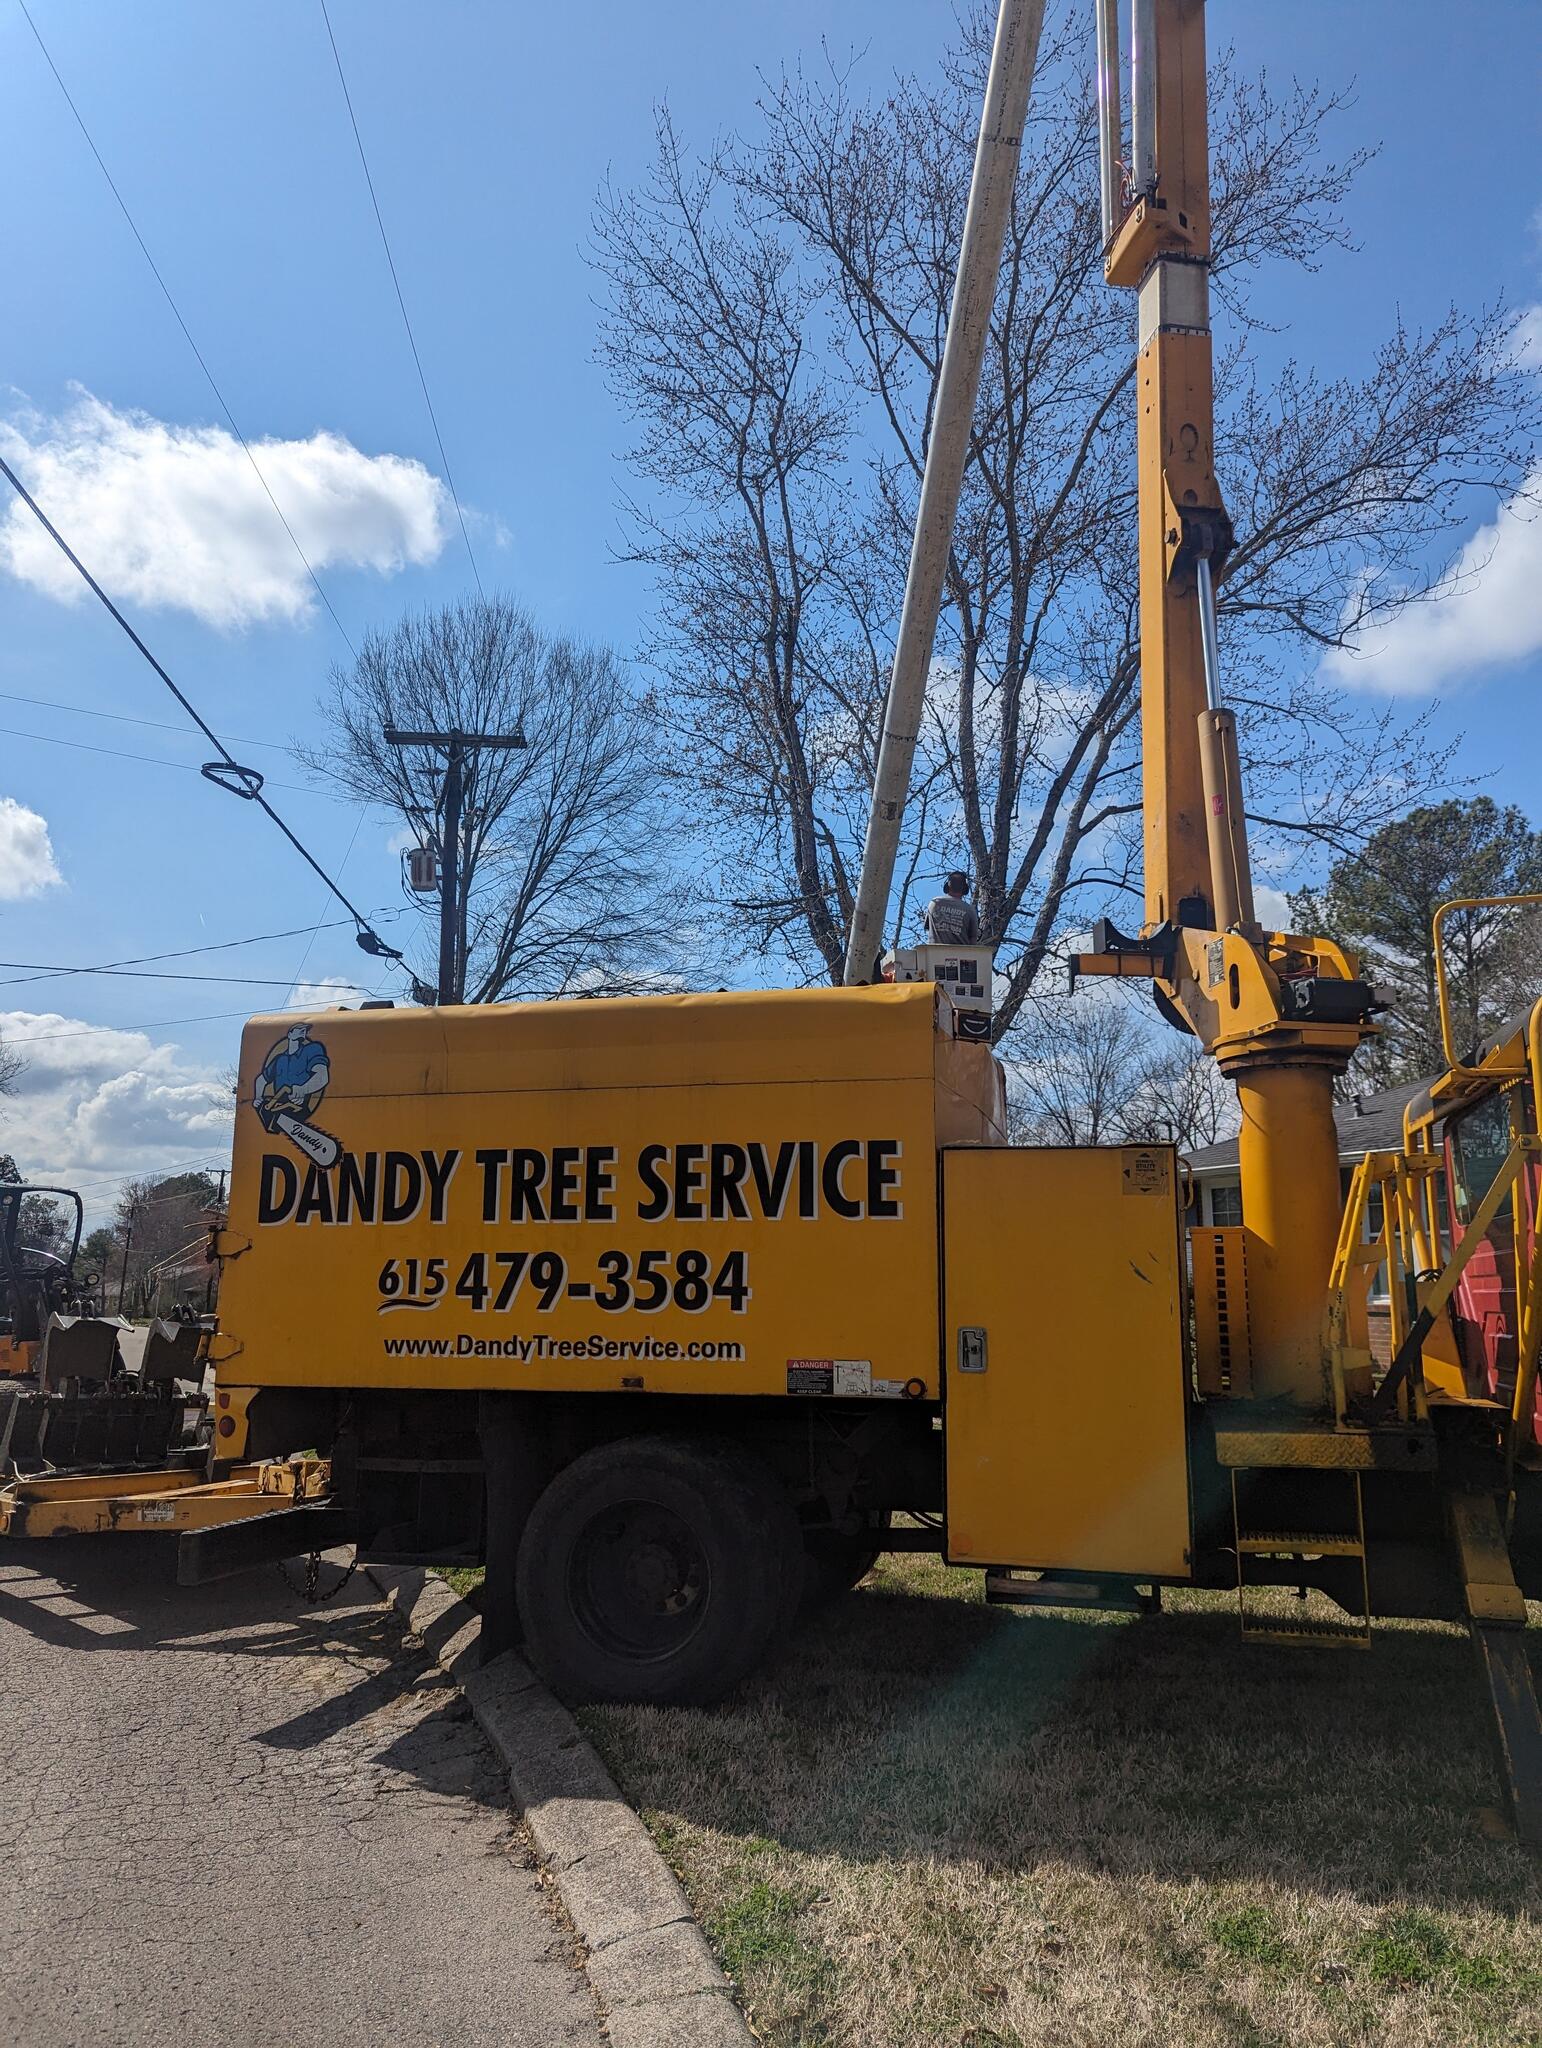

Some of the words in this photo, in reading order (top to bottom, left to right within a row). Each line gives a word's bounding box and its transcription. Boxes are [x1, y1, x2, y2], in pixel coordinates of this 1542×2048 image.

[291, 1123, 322, 1151] Dandy
[257, 1149, 462, 1226] DANDY
[475, 1146, 618, 1225] TREE
[636, 1138, 902, 1222] SERVICE
[377, 1257, 449, 1298] 615
[454, 1250, 752, 1314] 479-3584
[383, 1334, 746, 1363] www.DandyTreeService.com
[800, 1361, 829, 1369] DANGER
